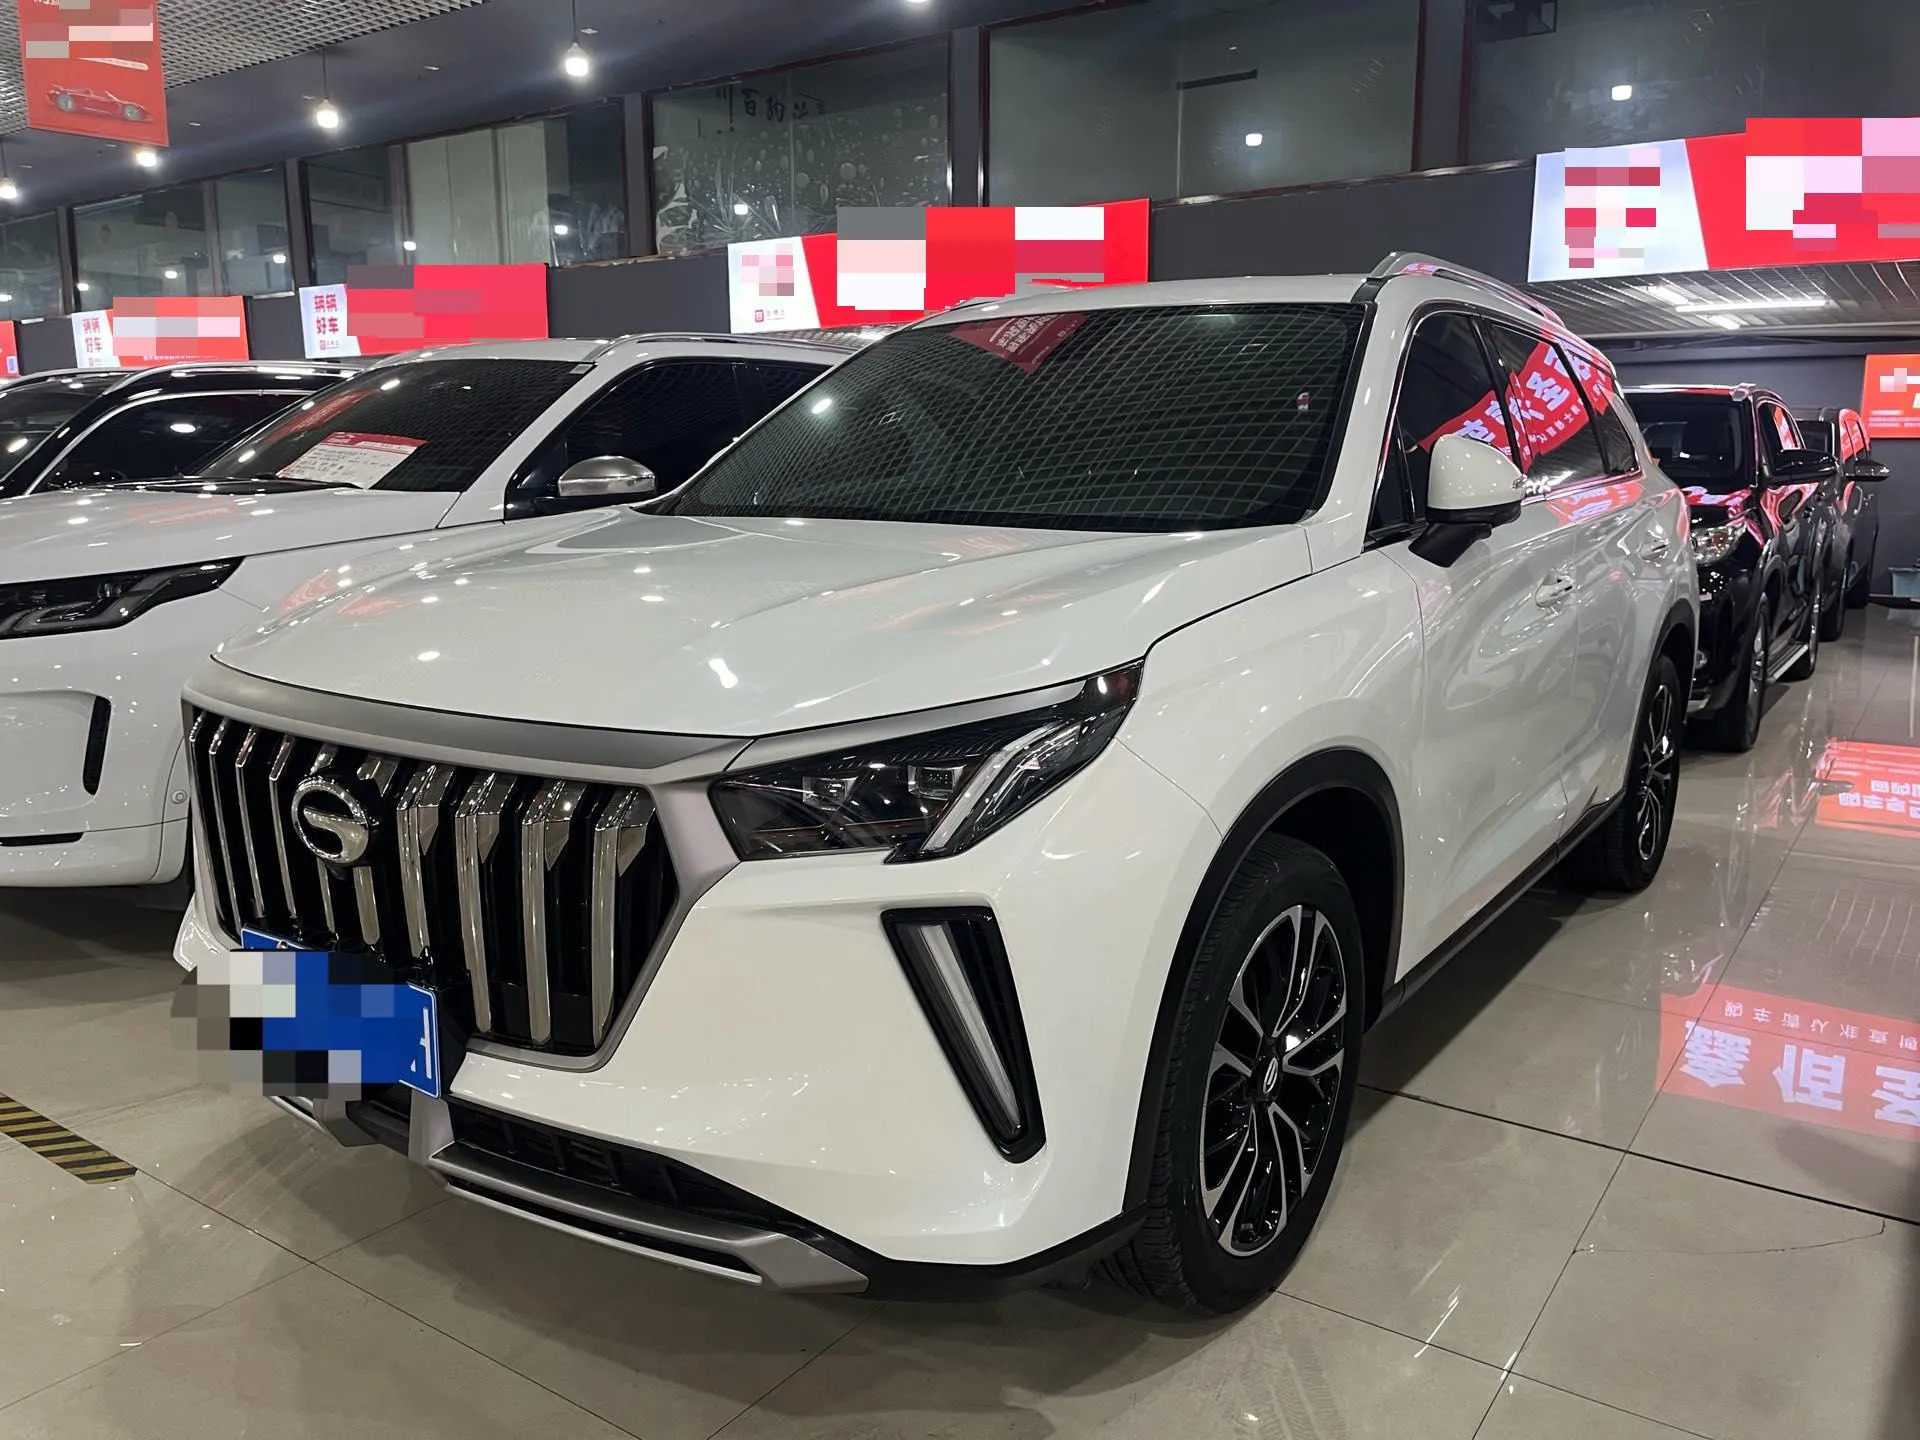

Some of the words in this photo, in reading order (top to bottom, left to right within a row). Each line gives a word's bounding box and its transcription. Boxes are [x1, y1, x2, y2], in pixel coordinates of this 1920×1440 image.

[314, 293, 338, 313] 辆辆
[315, 316, 340, 335] 好车
[85, 336, 104, 353] 好车
